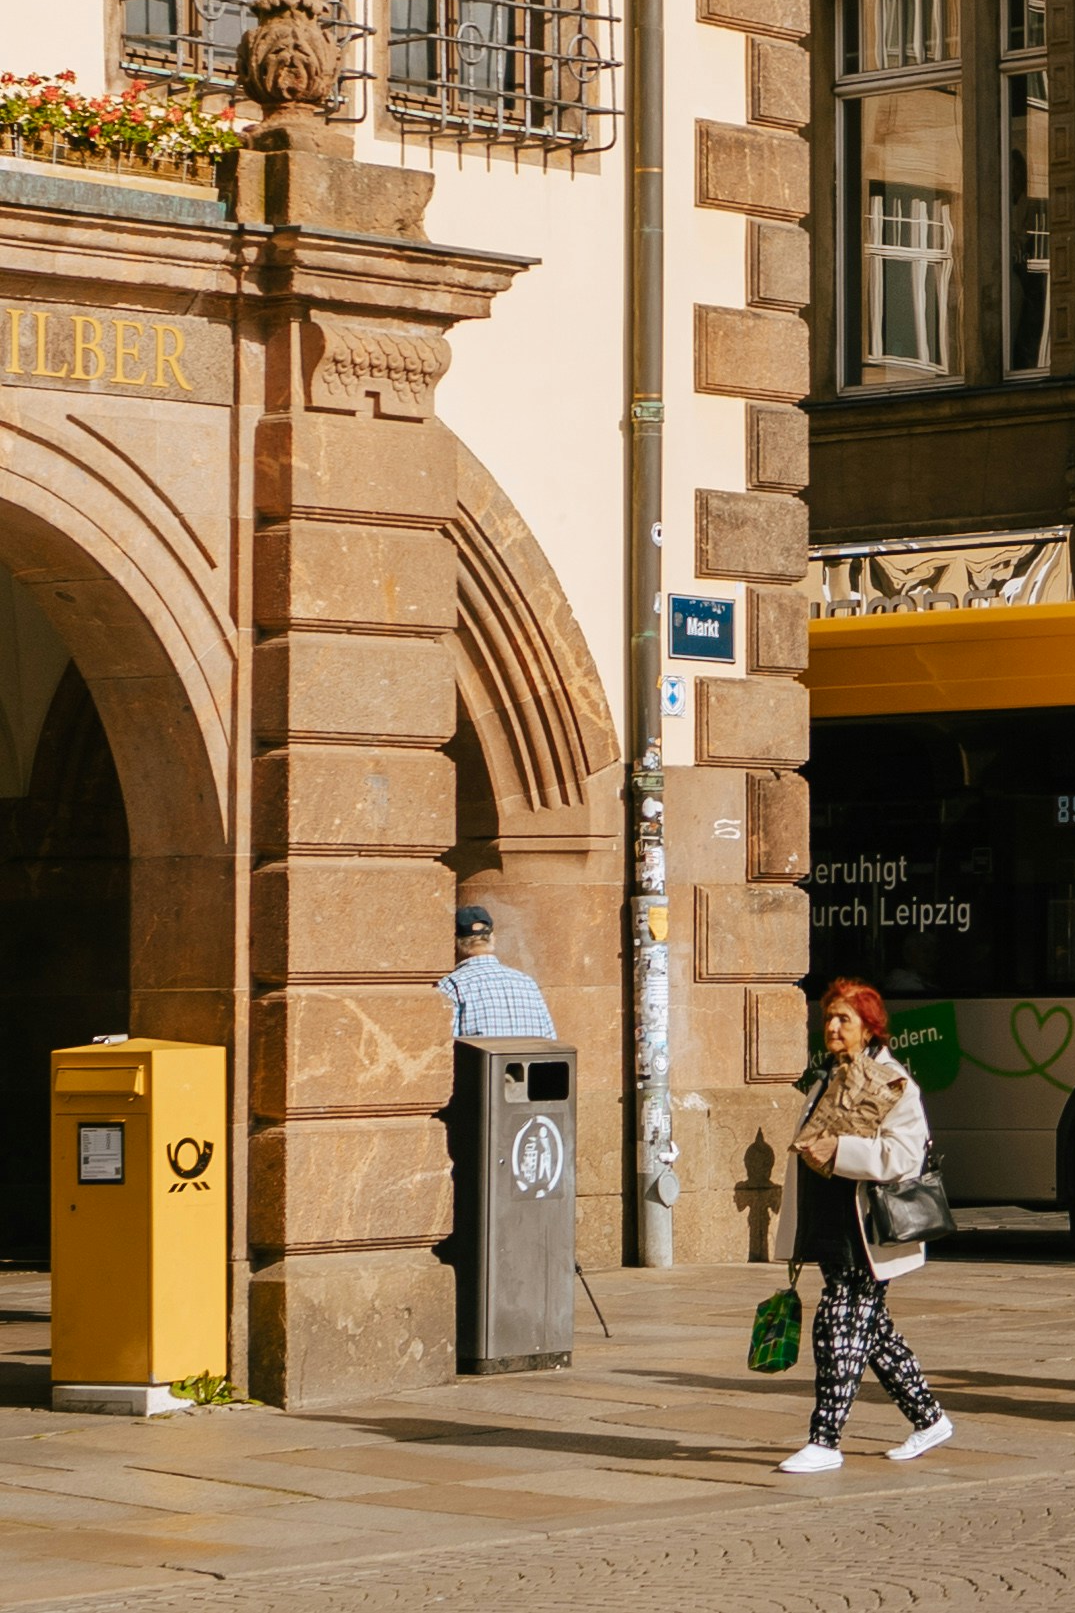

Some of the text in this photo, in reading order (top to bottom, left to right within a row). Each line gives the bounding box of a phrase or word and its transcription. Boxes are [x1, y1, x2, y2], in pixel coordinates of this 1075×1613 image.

[5, 308, 193, 391] ILBER
[686, 617, 720, 638] Markt
[812, 896, 971, 933] urch Leipzig
[889, 1027, 943, 1050] odern.
